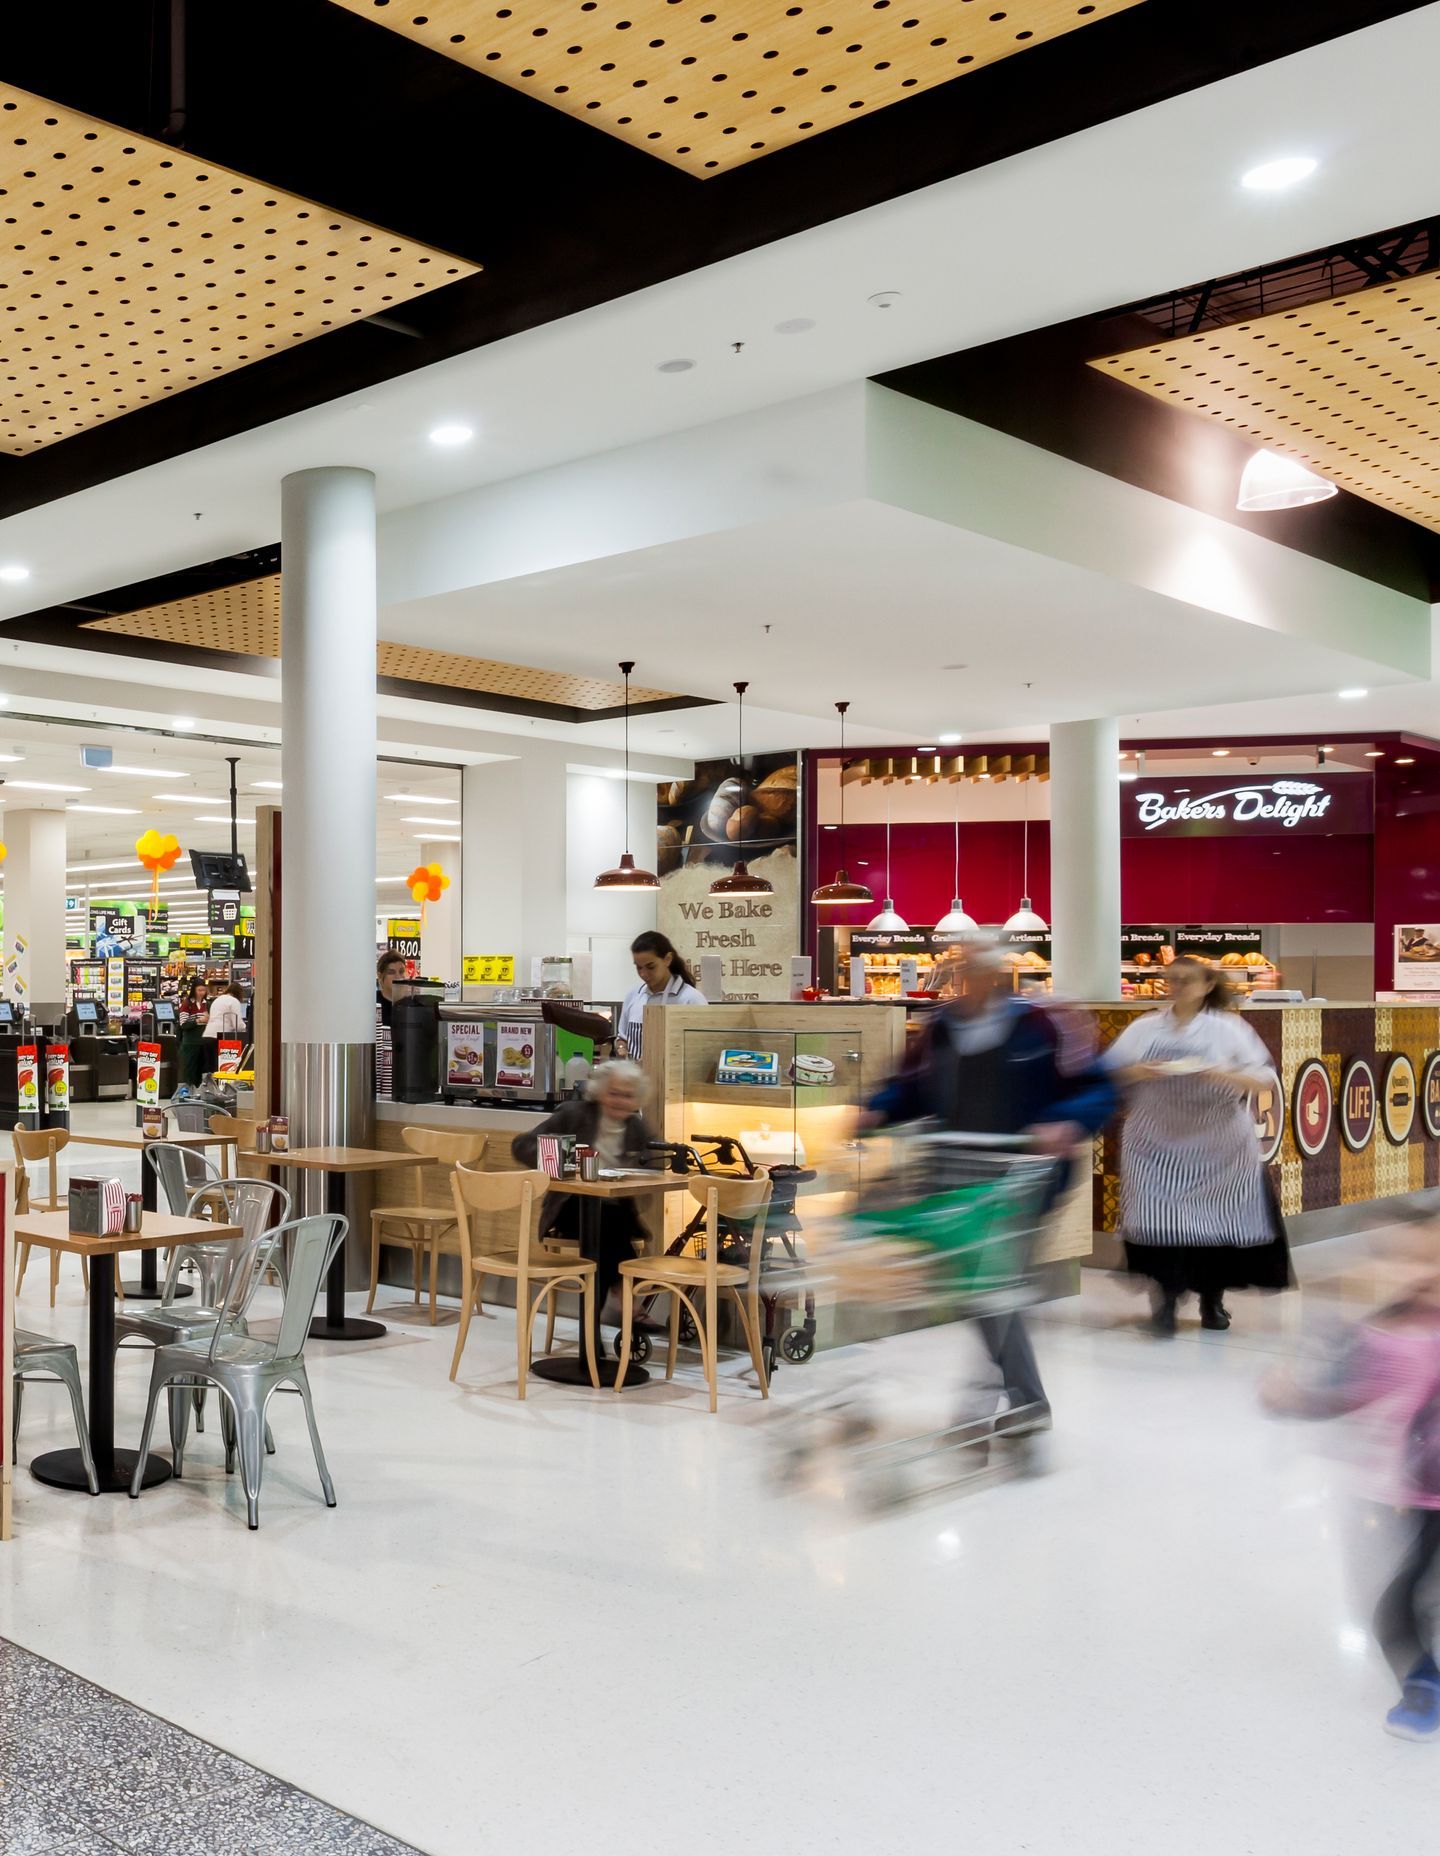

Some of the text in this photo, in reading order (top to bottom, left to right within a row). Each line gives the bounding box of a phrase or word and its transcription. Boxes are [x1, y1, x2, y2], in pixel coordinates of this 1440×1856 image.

[1135, 791, 1332, 830] Bakers Delight
[678, 899, 773, 920] We Bake
[112, 918, 128, 927] Gift
[108, 926, 132, 934] Cards
[695, 928, 757, 948] Fresh
[852, 934, 925, 944] Everyday Breads
[931, 934, 960, 943] Grain
[1009, 934, 1043, 942] Artisan
[1130, 933, 1165, 941] Breads
[1177, 932, 1261, 942] Everyday Breads
[729, 959, 783, 977] Here
[451, 1024, 480, 1035] SPECIAL
[500, 1026, 532, 1035] BRAND NEW
[1348, 1085, 1371, 1120] LIFE
